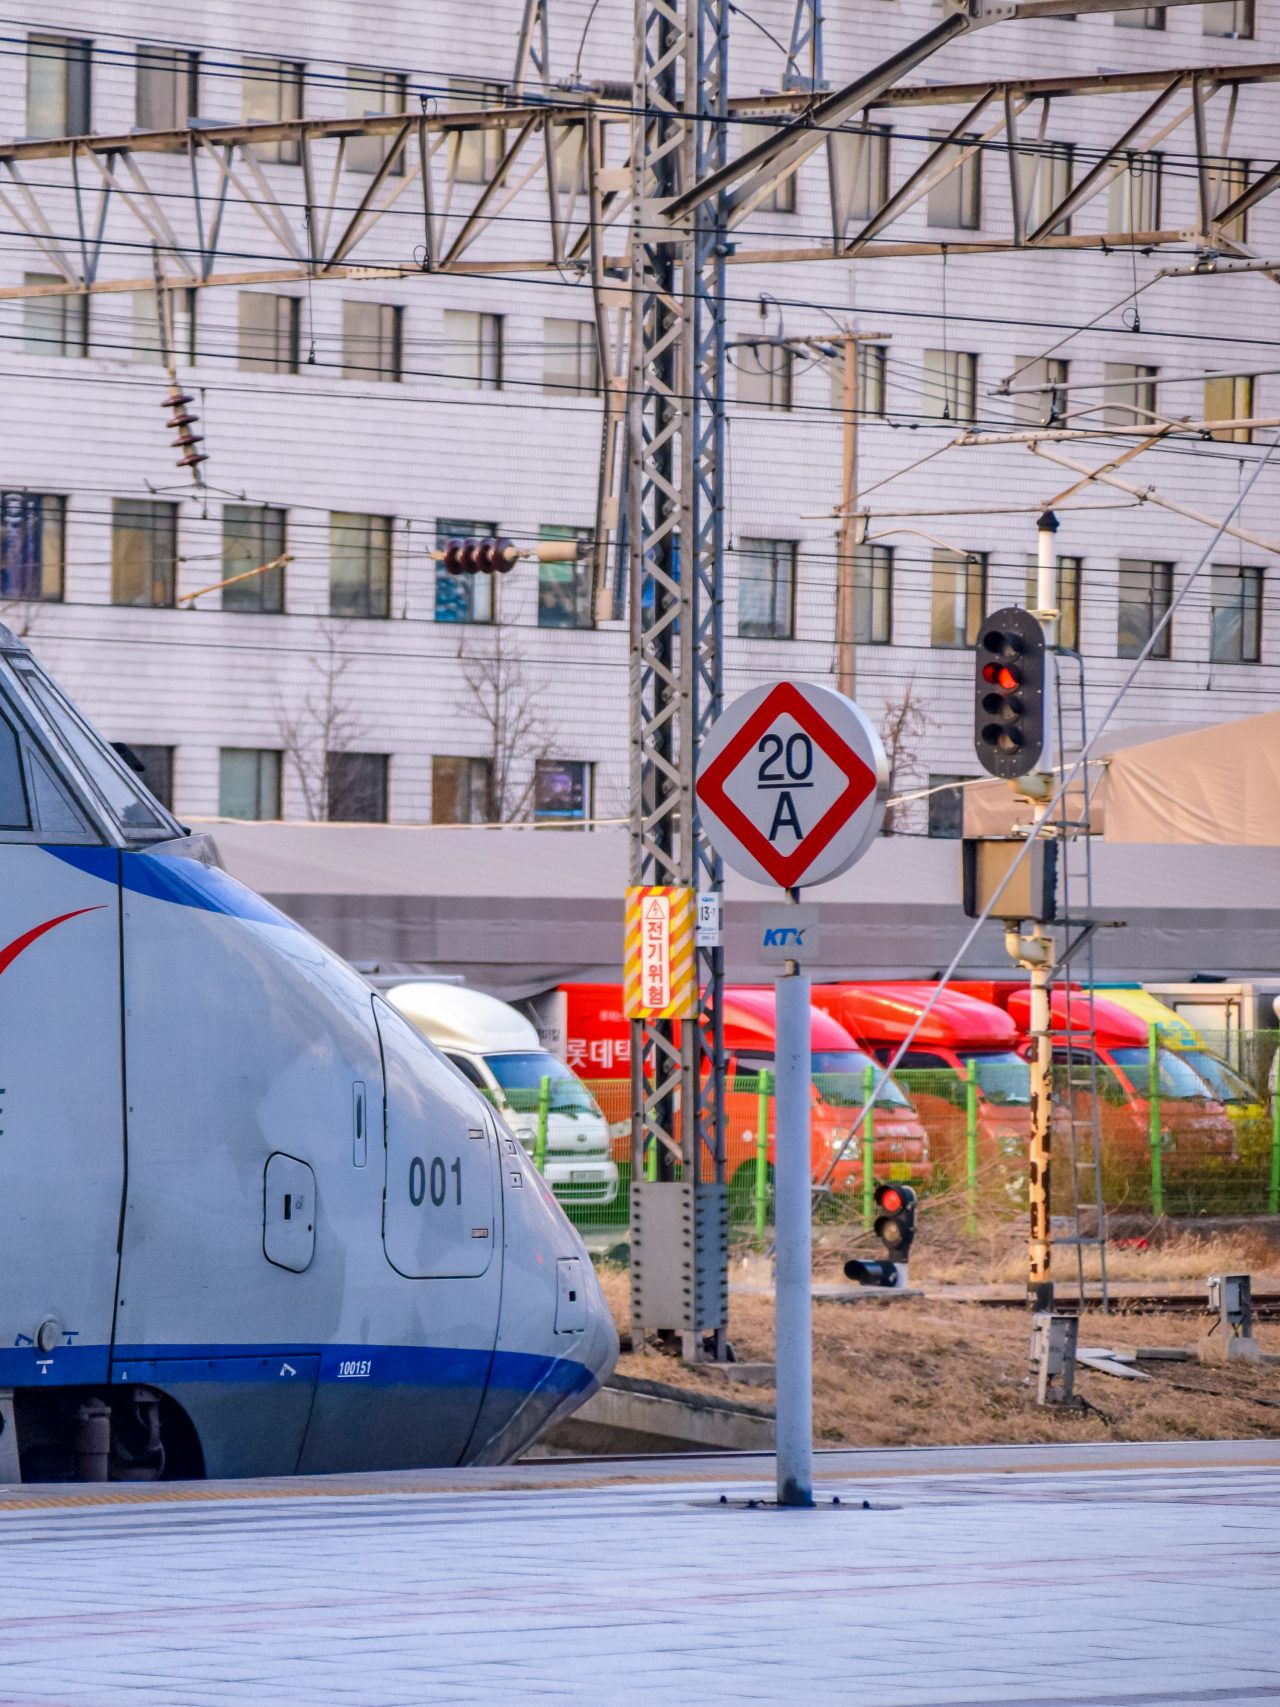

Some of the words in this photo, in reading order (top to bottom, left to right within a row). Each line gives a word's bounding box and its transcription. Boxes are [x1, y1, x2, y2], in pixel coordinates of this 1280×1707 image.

[758, 732, 813, 781] 20
[768, 791, 804, 841] A
[763, 925, 813, 946] KTX
[648, 921, 664, 1006] 전기위험
[409, 1156, 462, 1207] 001
[339, 1360, 371, 1375] 100151
